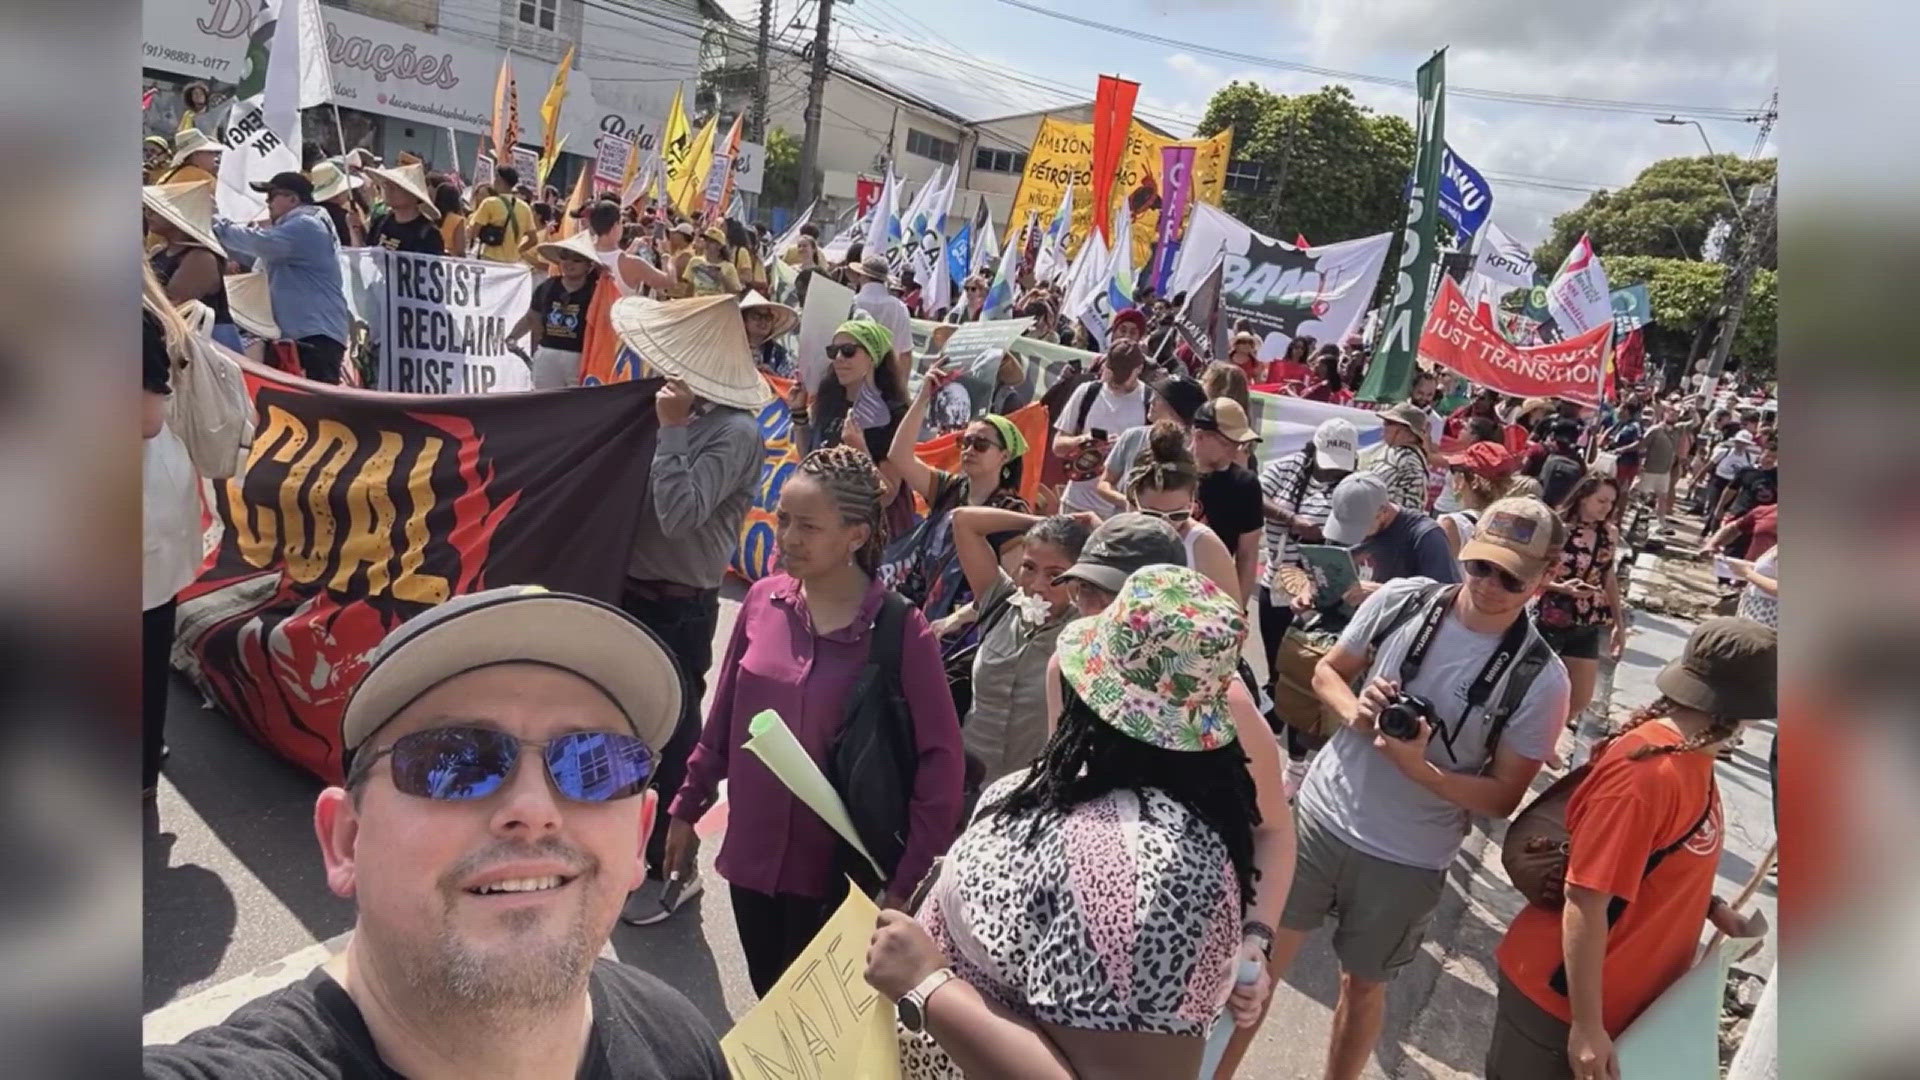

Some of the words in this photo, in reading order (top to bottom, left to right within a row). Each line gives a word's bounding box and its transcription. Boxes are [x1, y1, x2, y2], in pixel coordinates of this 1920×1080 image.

[397, 256, 486, 307] RESIST
[1485, 252, 1525, 277] KPTU
[397, 306, 506, 356] RECLAIM
[1429, 318, 1476, 350] JUST
[1479, 341, 1602, 383] TRANSITION
[399, 356, 454, 394] RISE
[462, 363, 496, 394] UP
[227, 405, 451, 602] COAL
[1429, 606, 1444, 624] EOS
[1411, 625, 1434, 657] DIGITAL
[1484, 651, 1510, 683] Canon
[732, 934, 880, 1080] MATE
